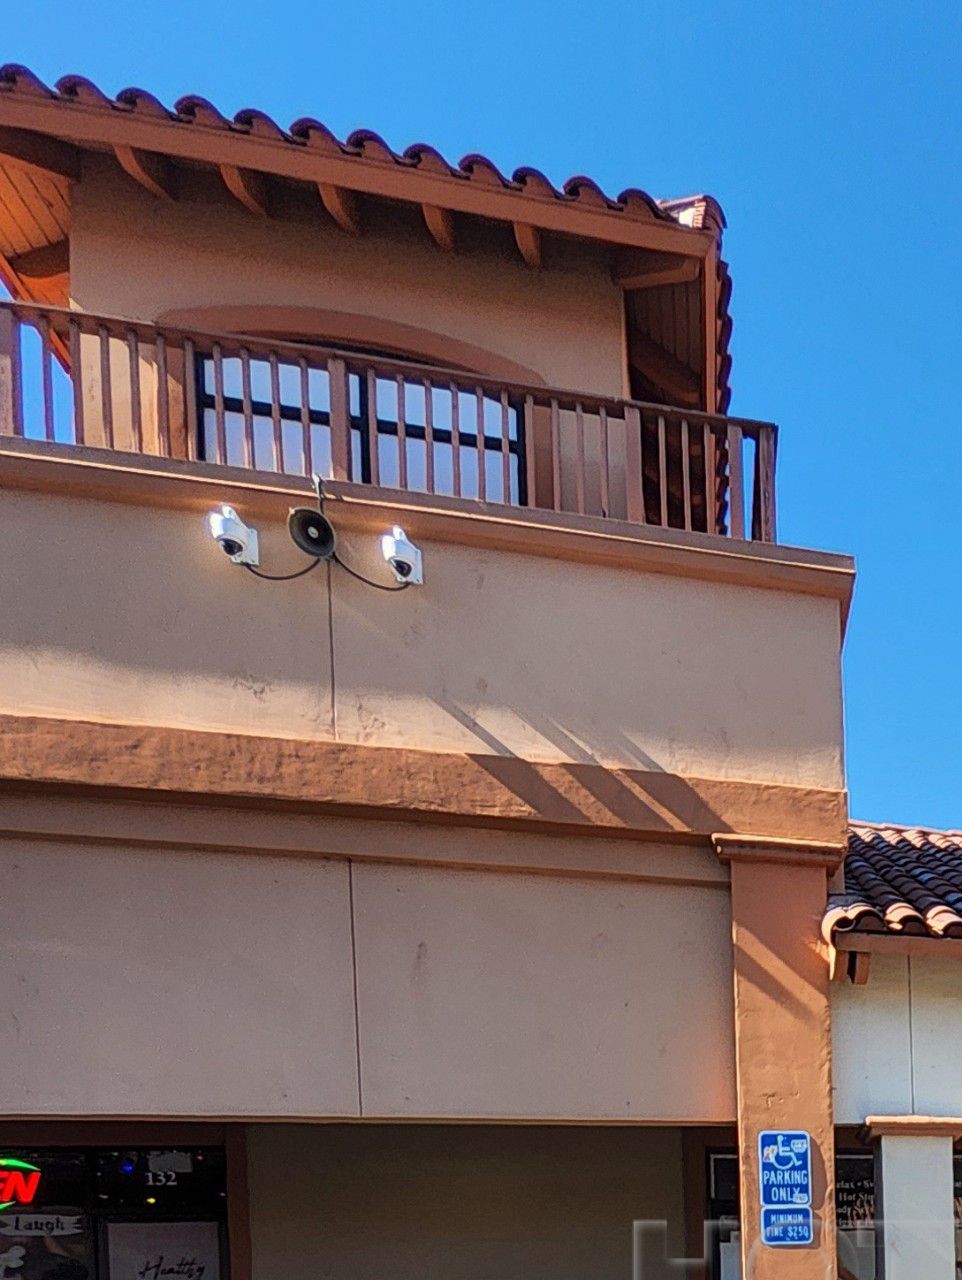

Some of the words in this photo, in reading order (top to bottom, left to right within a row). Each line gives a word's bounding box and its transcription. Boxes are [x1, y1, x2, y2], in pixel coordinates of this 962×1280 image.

[145, 1171, 178, 1186] 132
[763, 1170, 808, 1185] PARKING
[771, 1187, 801, 1201] ONLY
[770, 1214, 804, 1224] MINIMUM
[766, 1226, 784, 1237] FINE
